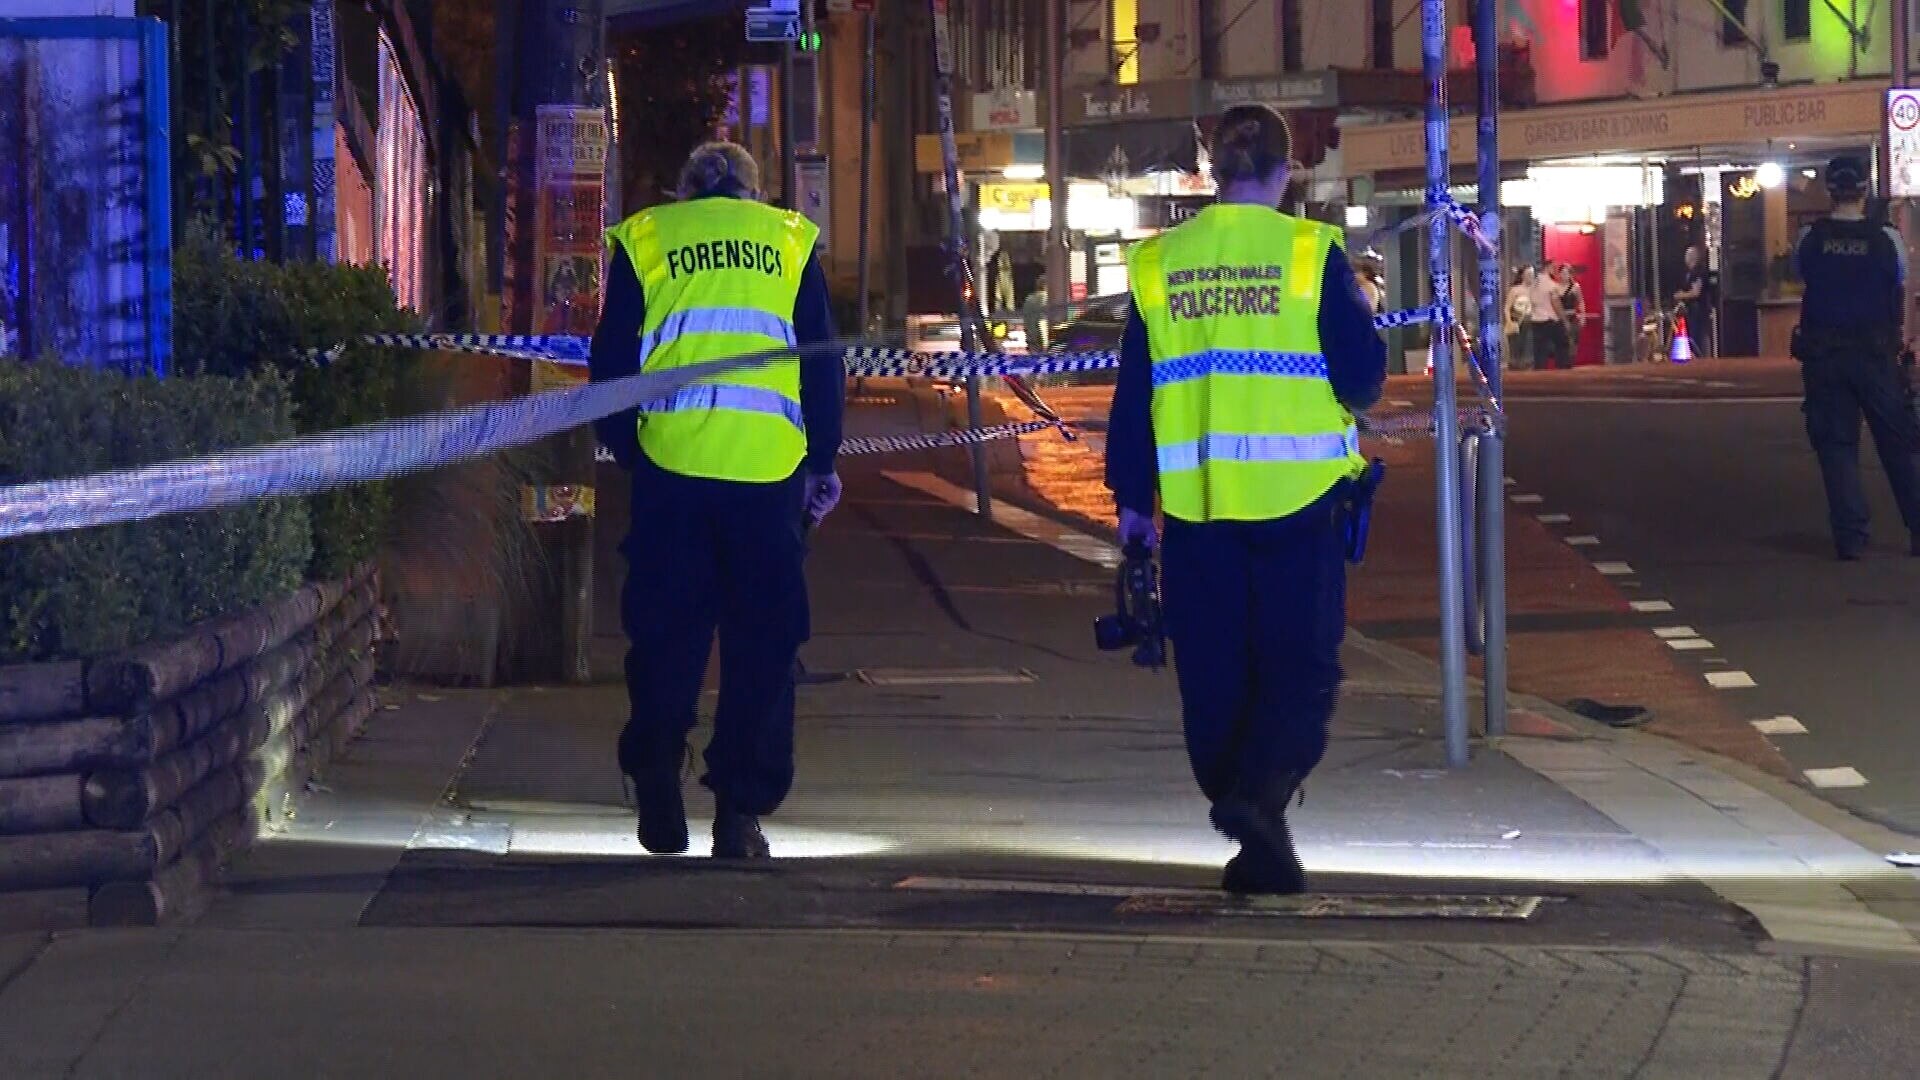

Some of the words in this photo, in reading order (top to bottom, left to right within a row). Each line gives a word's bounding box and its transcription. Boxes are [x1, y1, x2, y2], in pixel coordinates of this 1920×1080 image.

[1743, 102, 1795, 127] PUBLIC
[1798, 99, 1826, 123] BAR
[1896, 104, 1916, 121] 40
[1524, 121, 1578, 145] GARDEN
[1581, 117, 1608, 141] BAR
[1623, 112, 1669, 136] DINING
[1390, 134, 1417, 156] LIVE
[667, 239, 783, 279] FORENSICS
[1823, 240, 1869, 255] POLICE
[1167, 269, 1195, 287] NEW
[1197, 264, 1237, 281] SOUTH
[1239, 264, 1282, 280] WALES
[1168, 288, 1222, 322] POLICE
[1223, 285, 1280, 315] FORCE
